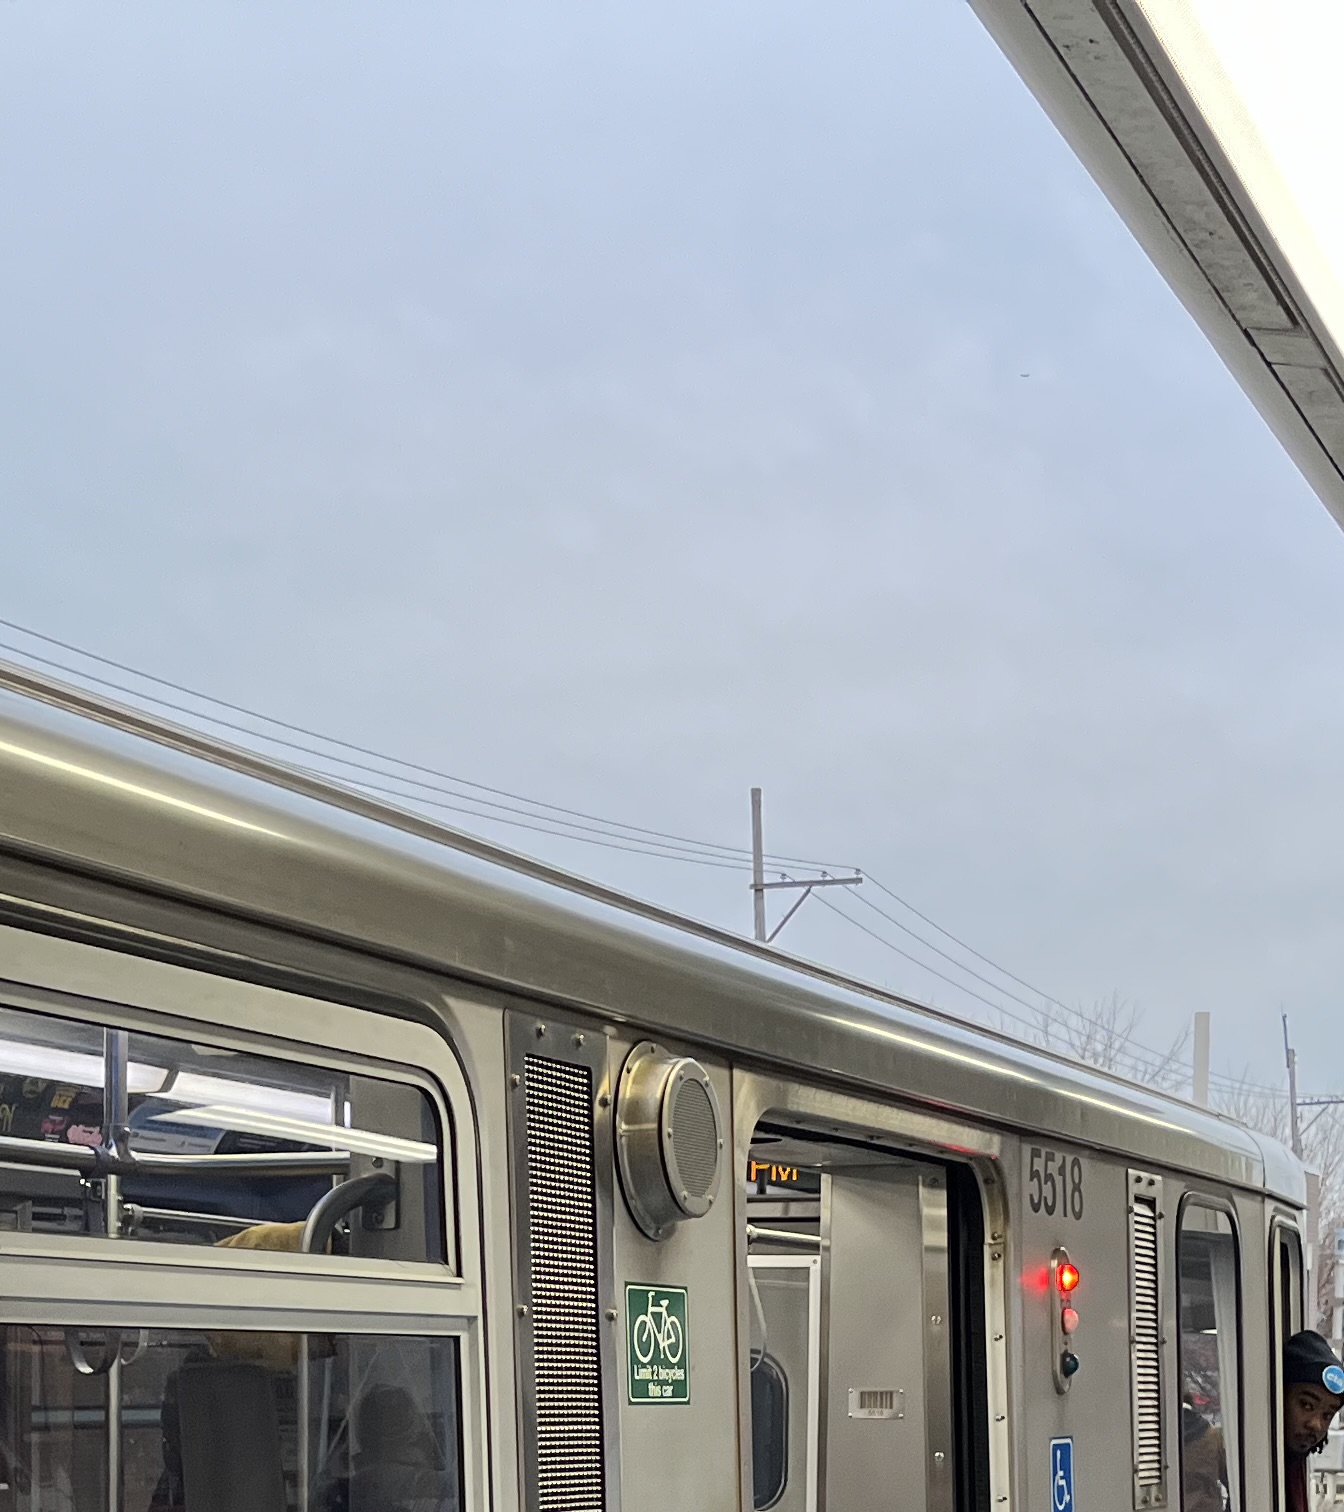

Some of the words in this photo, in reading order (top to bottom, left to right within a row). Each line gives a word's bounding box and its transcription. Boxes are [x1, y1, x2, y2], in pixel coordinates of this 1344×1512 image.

[1029, 1147, 1083, 1221] 5518
[634, 1365, 652, 1379] Limit
[653, 1365, 658, 1379] 2
[659, 1365, 684, 1383] bicycles
[648, 1382, 661, 1396] this
[662, 1386, 673, 1396] car
